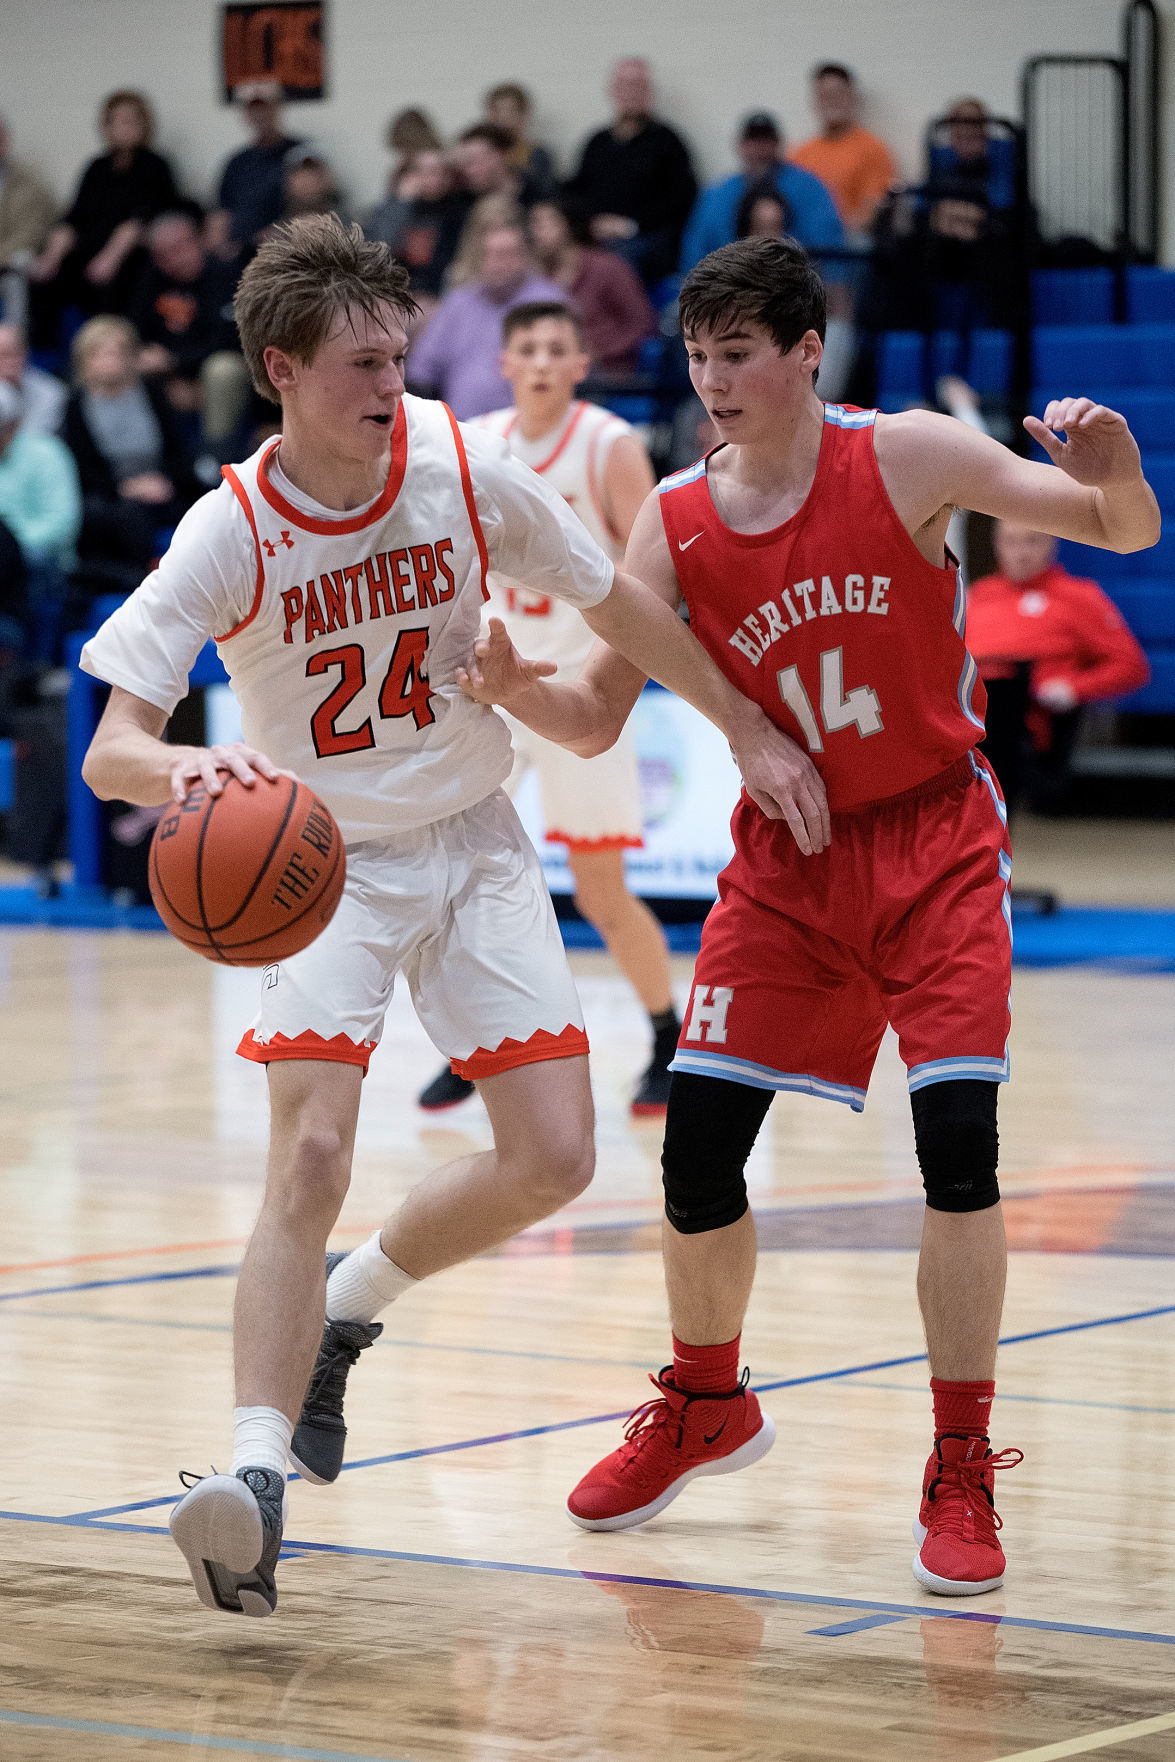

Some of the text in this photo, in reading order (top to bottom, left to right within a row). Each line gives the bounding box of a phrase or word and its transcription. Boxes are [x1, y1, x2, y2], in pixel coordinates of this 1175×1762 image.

[280, 538, 455, 644] PANTHERS
[728, 574, 891, 667] HERITAGE
[305, 626, 436, 759] 24
[776, 645, 885, 752] 14
[271, 852, 320, 911] THE
[685, 985, 735, 1044] H
